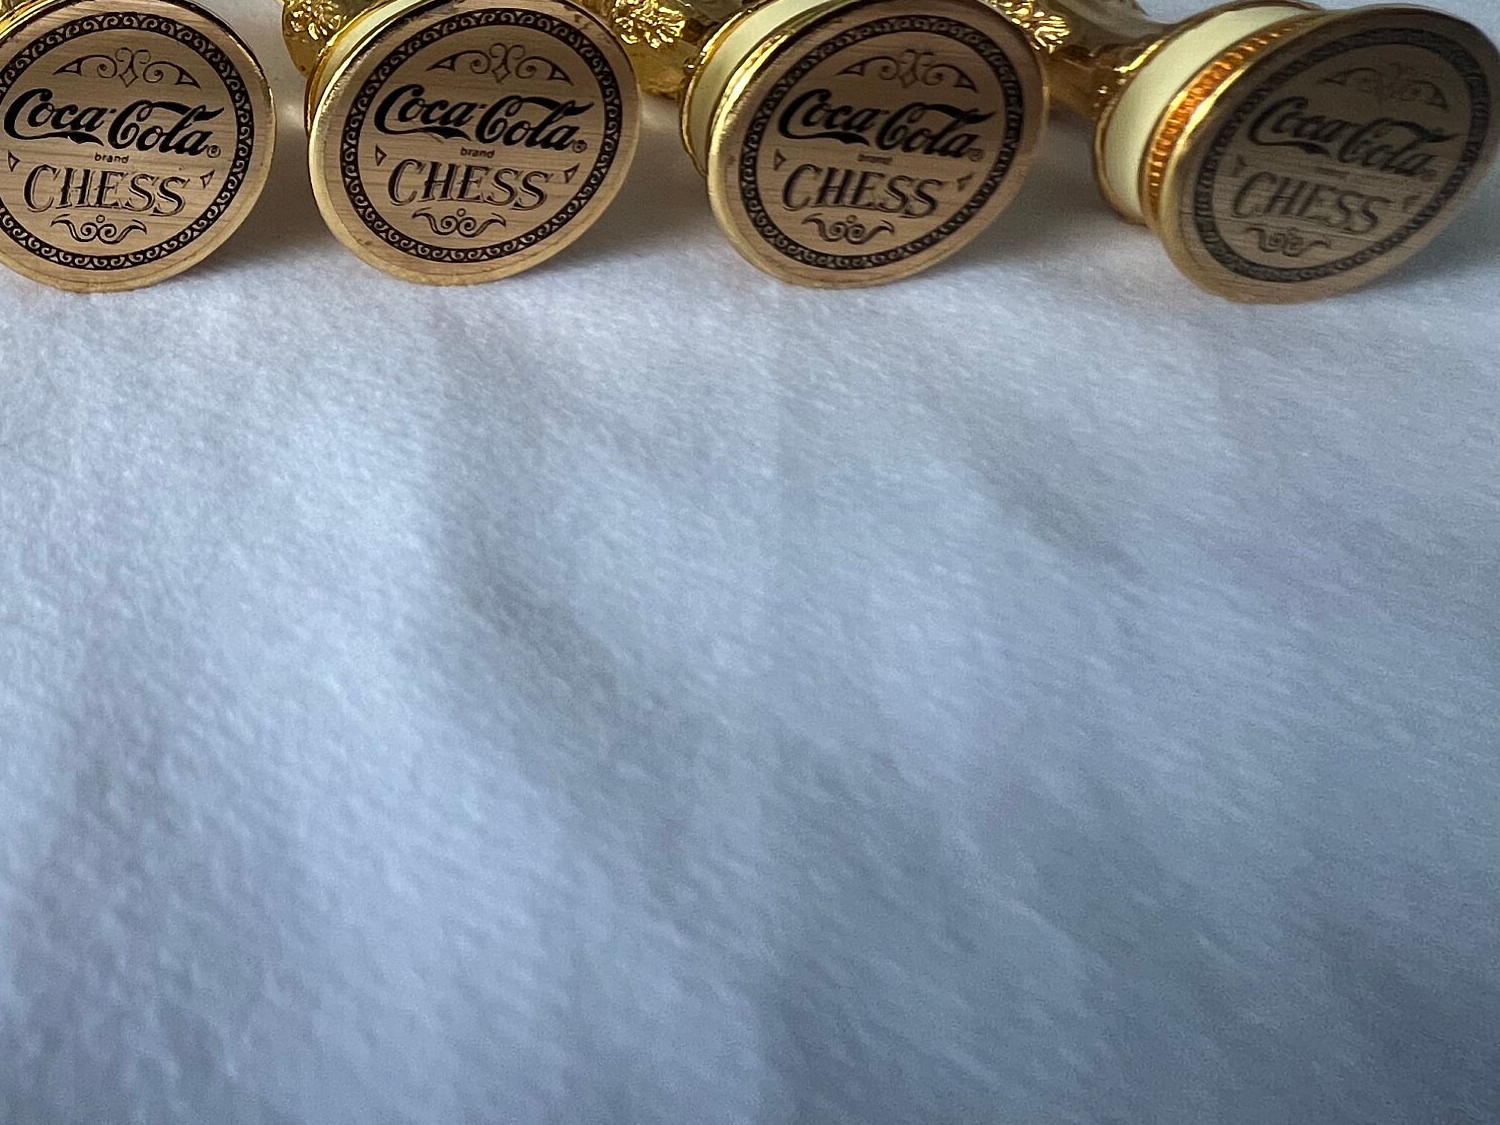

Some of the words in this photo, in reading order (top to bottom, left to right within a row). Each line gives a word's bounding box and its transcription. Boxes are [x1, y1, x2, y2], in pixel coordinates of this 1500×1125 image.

[94, 152, 129, 164] brand
[460, 147, 495, 159] brand
[23, 164, 190, 217] CHESS
[388, 158, 554, 211] CHESS
[782, 163, 944, 219] CHESS
[1231, 171, 1395, 235] CHESS
